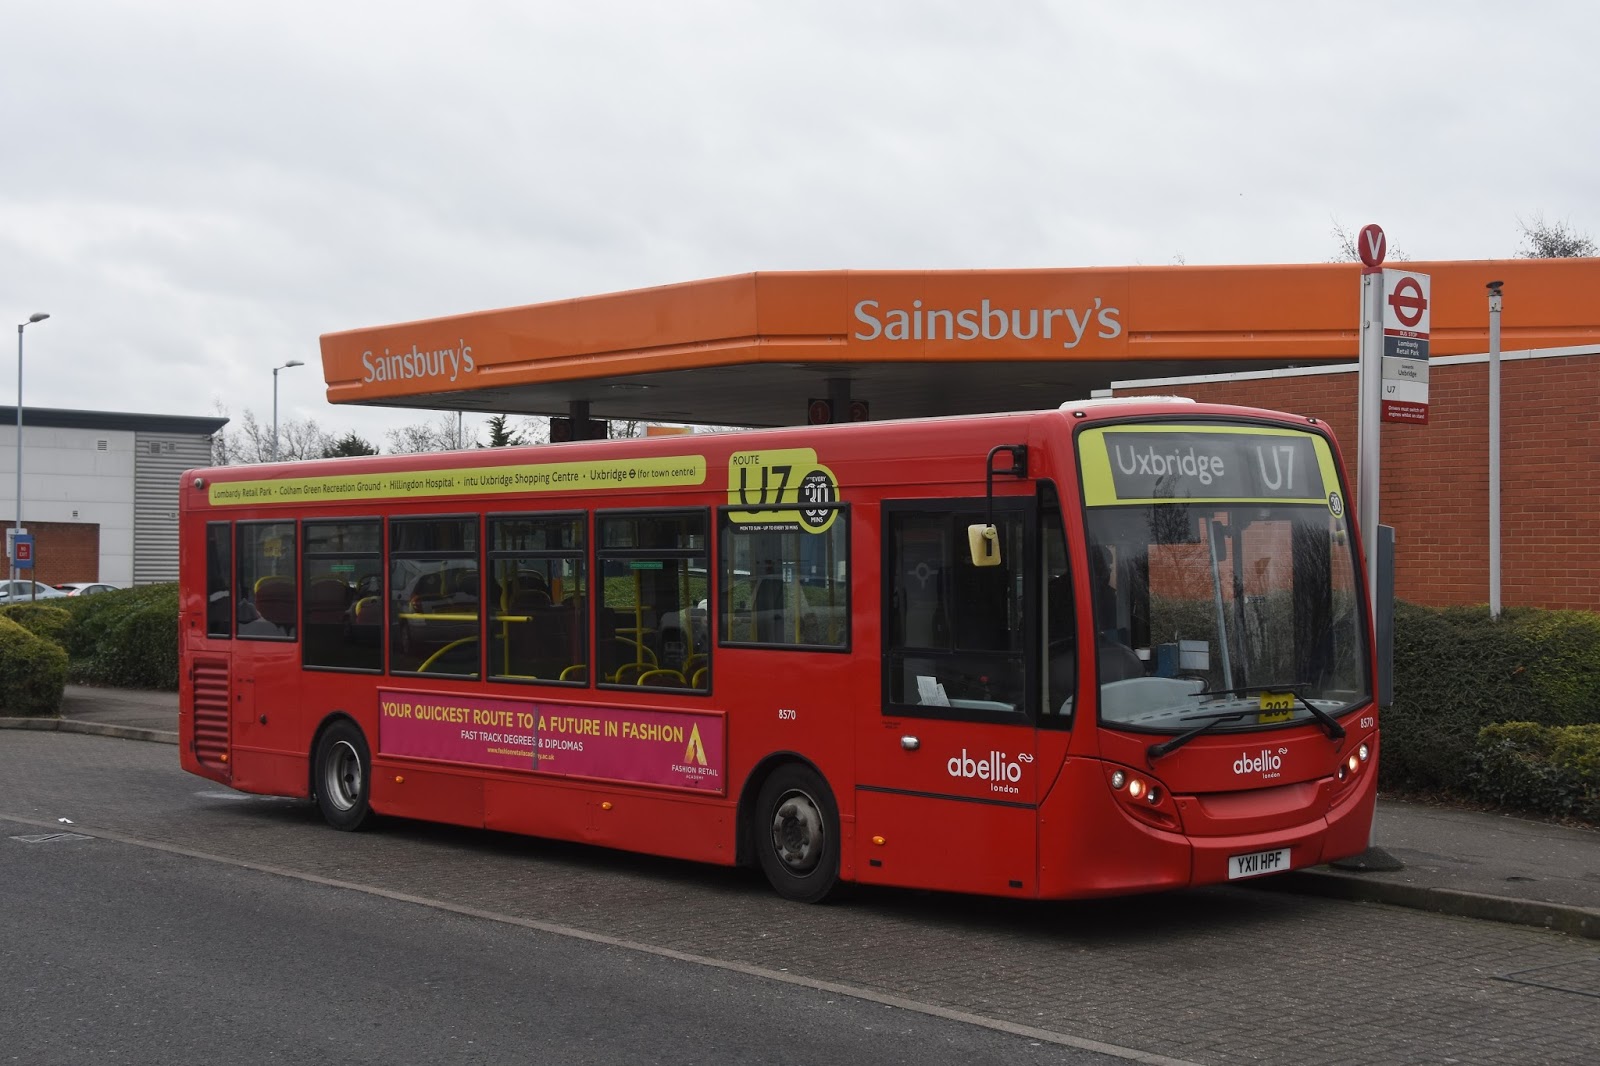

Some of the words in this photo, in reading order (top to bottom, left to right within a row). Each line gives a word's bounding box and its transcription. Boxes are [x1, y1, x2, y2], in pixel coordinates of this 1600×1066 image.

[1366, 230, 1383, 260] V
[853, 297, 1122, 349] Sainsbury's
[1398, 340, 1418, 349] Lombardy
[362, 338, 474, 382] Sainsbury's
[1398, 370, 1417, 378] Uxbridge
[733, 455, 760, 465] ROUTE
[1115, 445, 1224, 485] Uxbridge
[1257, 446, 1294, 490] U7
[213, 488, 241, 499] Lombardy
[242, 488, 258, 497] Retail
[259, 487, 272, 496] Park
[279, 486, 302, 496] Colham
[303, 485, 322, 495] Green
[323, 483, 356, 493] Recreation
[357, 482, 381, 492] Ground
[389, 480, 424, 491] Hillingdon
[425, 478, 454, 490] Hospital
[463, 477, 478, 486] intu
[480, 475, 513, 487] Uxbridge
[515, 473, 550, 485] Shopping
[552, 471, 579, 483] Centre
[590, 469, 627, 482] Uxbridge
[637, 468, 649, 480] (for
[652, 469, 669, 478] town
[671, 466, 696, 478] centre)
[740, 466, 792, 514] U7
[805, 483, 829, 516] 30
[778, 709, 796, 720] 8570
[1265, 701, 1289, 718] 203
[382, 702, 412, 718] YOUR
[415, 704, 470, 723] QUICKEST
[473, 709, 513, 727] ROUTE
[517, 712, 533, 729] TO
[537, 715, 547, 731] A
[550, 716, 600, 735] FUTURE
[604, 720, 618, 737] IN
[622, 722, 683, 743] FASHION
[1360, 716, 1374, 728] 8570
[460, 730, 478, 740] FAST
[479, 731, 502, 743] TRACK
[504, 734, 536, 746] DEGREES
[538, 738, 543, 747] &
[545, 738, 583, 751] DIPLOMAS
[671, 764, 697, 774] FASHION
[698, 767, 719, 777] RETAIL
[947, 748, 1021, 782] abellio
[1233, 750, 1281, 774] abellio
[991, 783, 1019, 794] london
[1238, 853, 1258, 874] YX11
[1260, 851, 1282, 871] HPF
